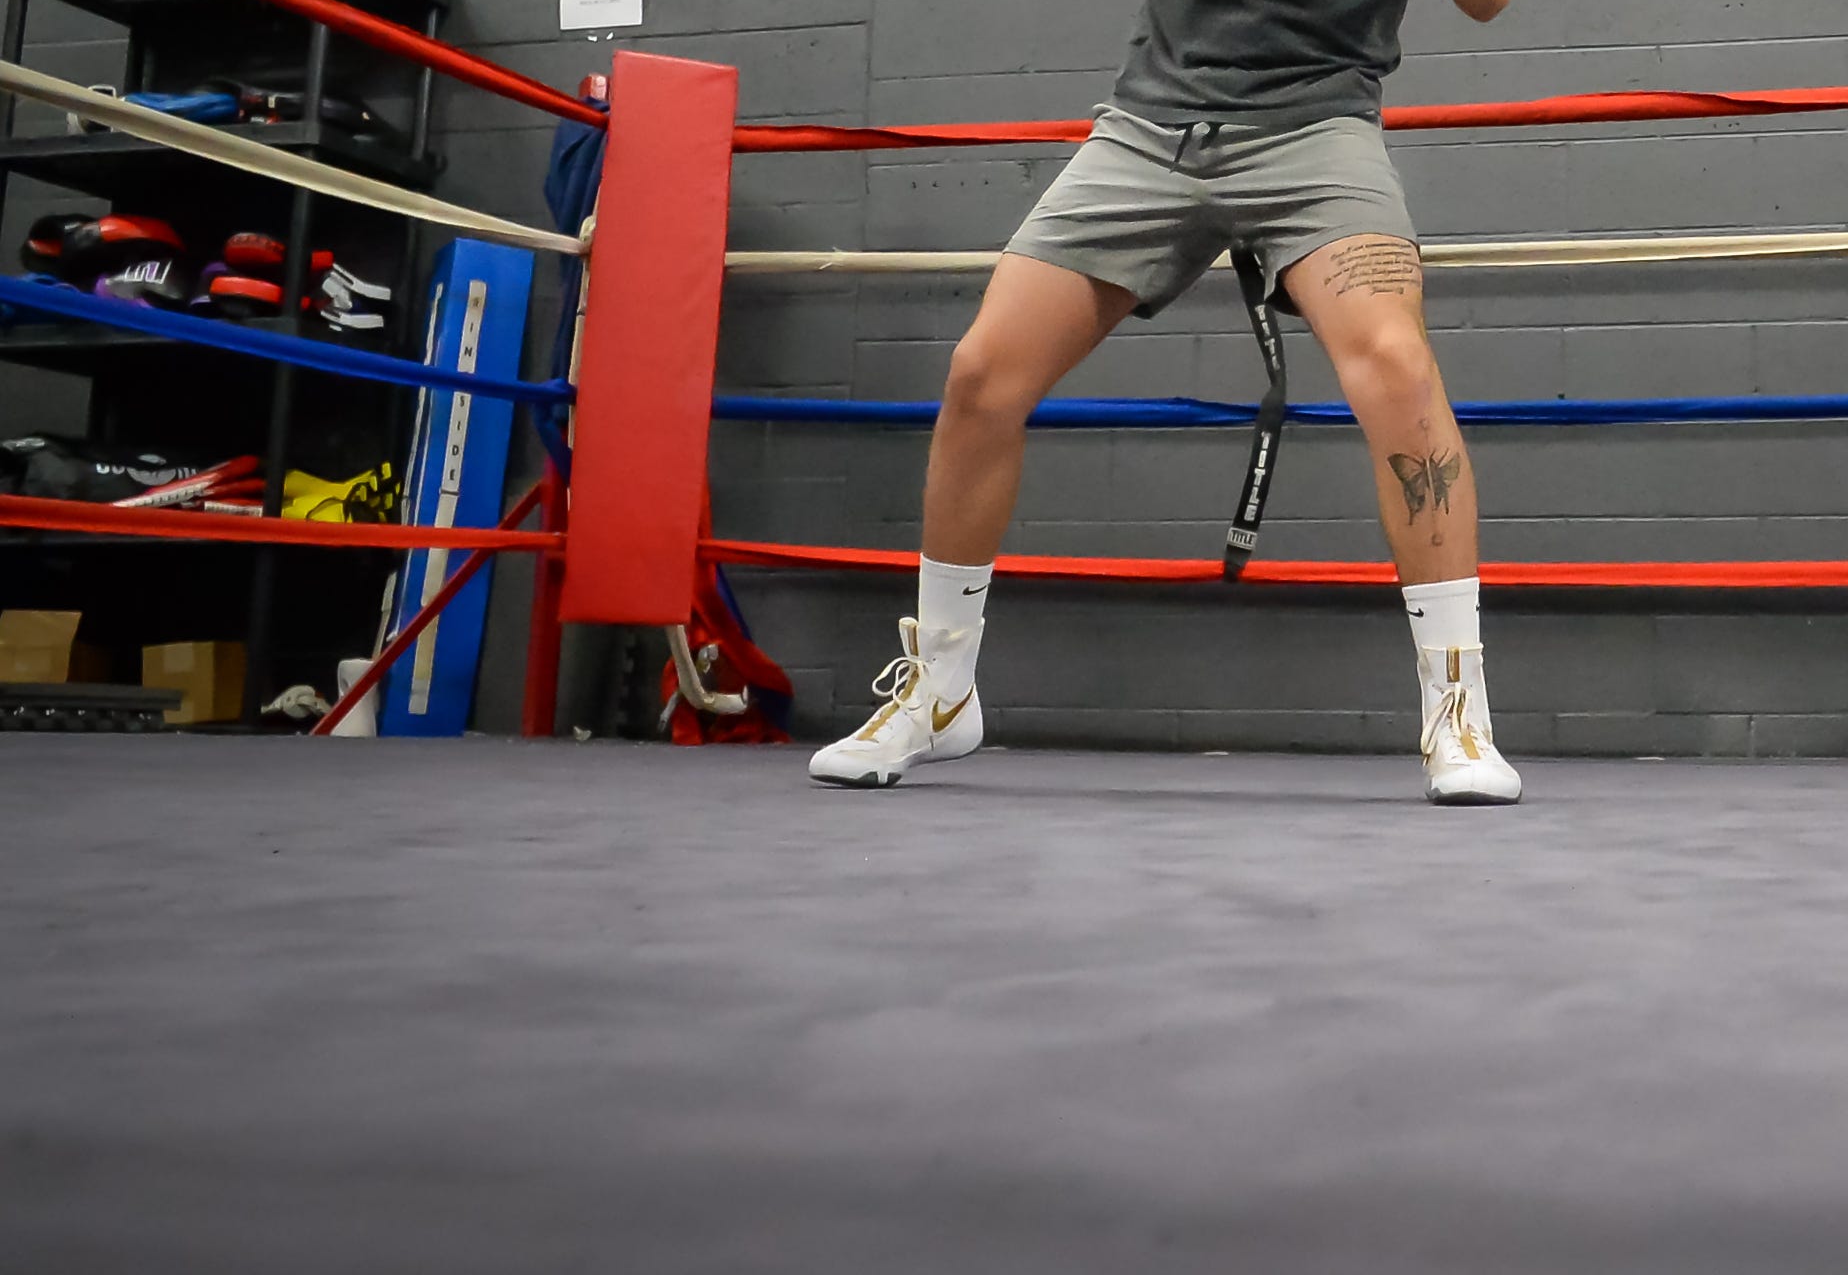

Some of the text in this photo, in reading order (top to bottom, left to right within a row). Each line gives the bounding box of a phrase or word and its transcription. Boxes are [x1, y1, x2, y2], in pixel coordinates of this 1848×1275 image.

[1255, 305, 1280, 371] TITL
[449, 296, 482, 481] RINSIDE
[1244, 431, 1271, 521] TITLE
